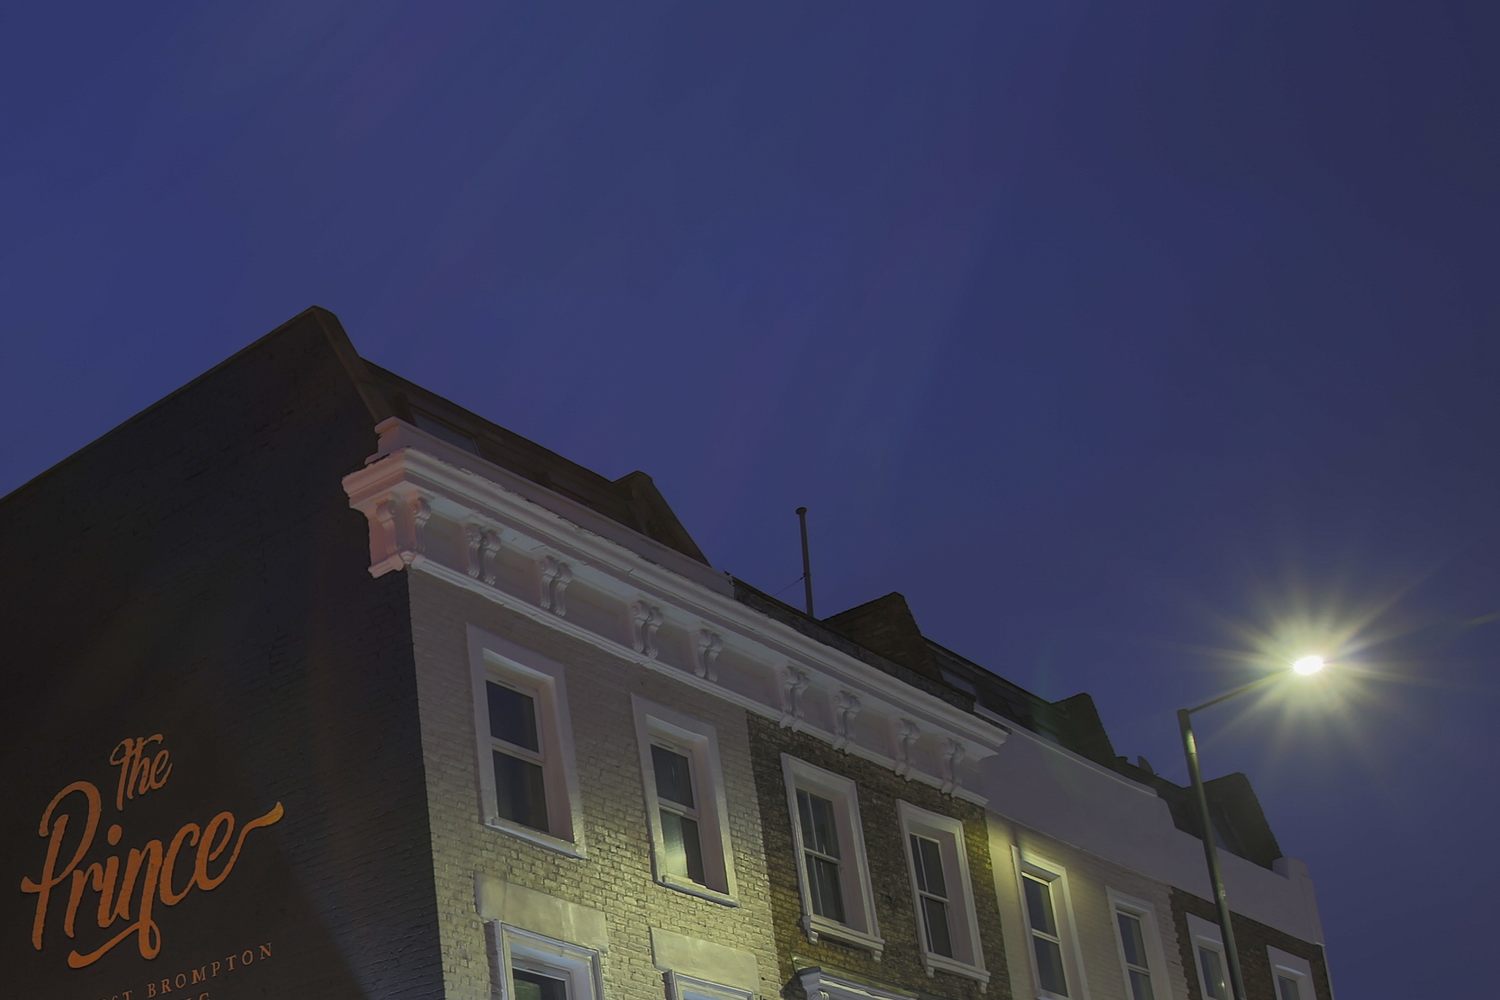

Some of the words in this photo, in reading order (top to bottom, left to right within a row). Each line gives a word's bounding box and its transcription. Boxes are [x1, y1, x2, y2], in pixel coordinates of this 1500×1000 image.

[109, 734, 173, 811] The
[21, 781, 284, 968] Prince
[147, 942, 274, 999] BROMPTON
